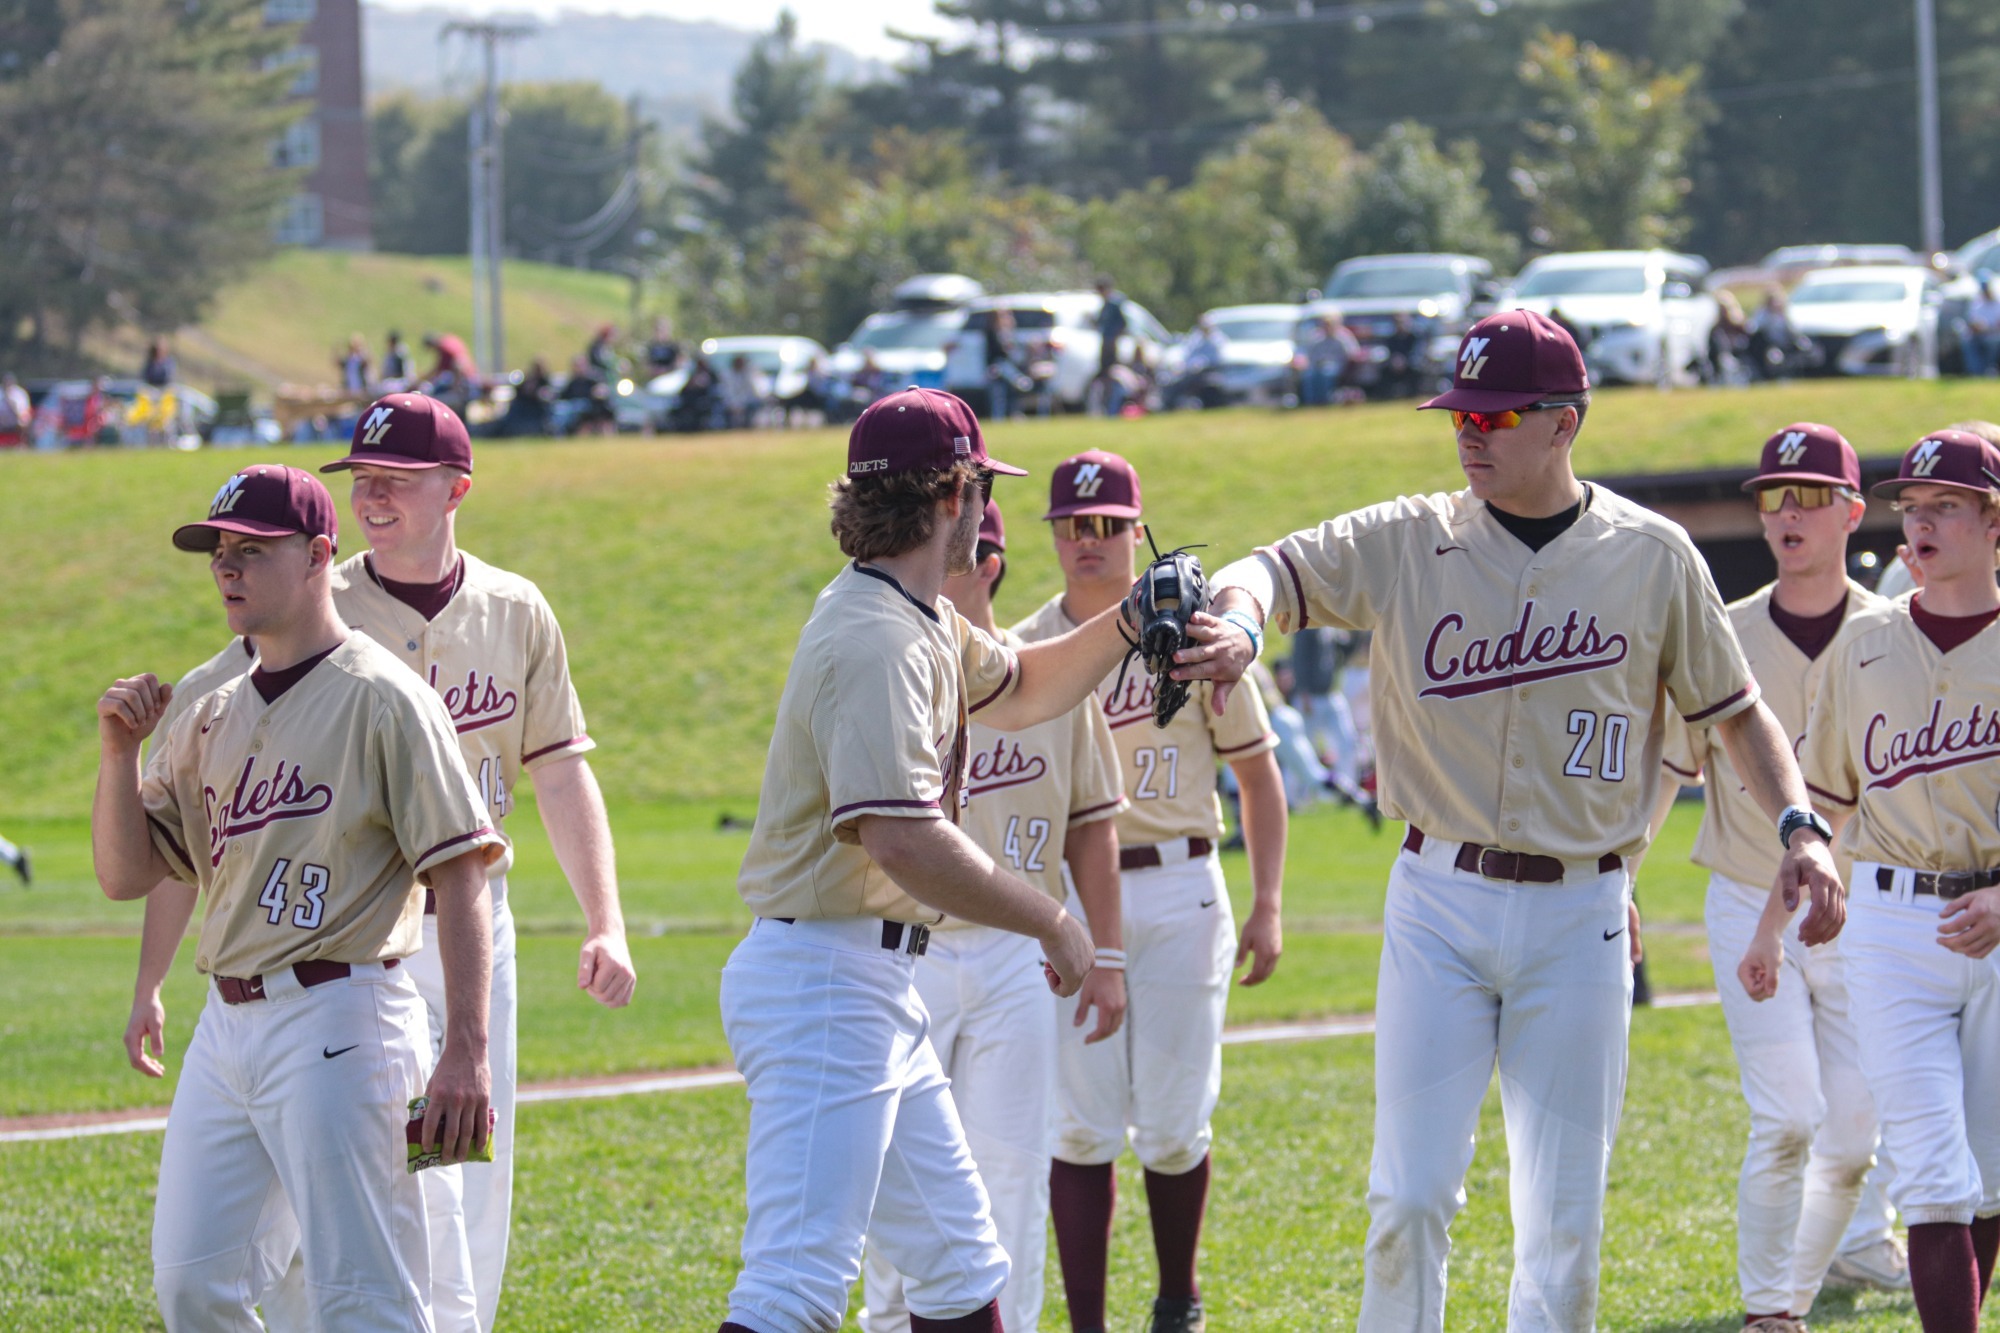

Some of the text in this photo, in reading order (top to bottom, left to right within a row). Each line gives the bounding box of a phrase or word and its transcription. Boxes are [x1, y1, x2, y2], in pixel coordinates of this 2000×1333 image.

[1460, 337, 1490, 380] NU
[363, 407, 395, 445] NU
[849, 458, 888, 473] CADETS
[1421, 599, 1630, 692] Cadets
[1135, 746, 1179, 799] 27
[1563, 708, 1630, 783] 20
[1004, 814, 1052, 872] 42
[257, 857, 331, 931] 43
